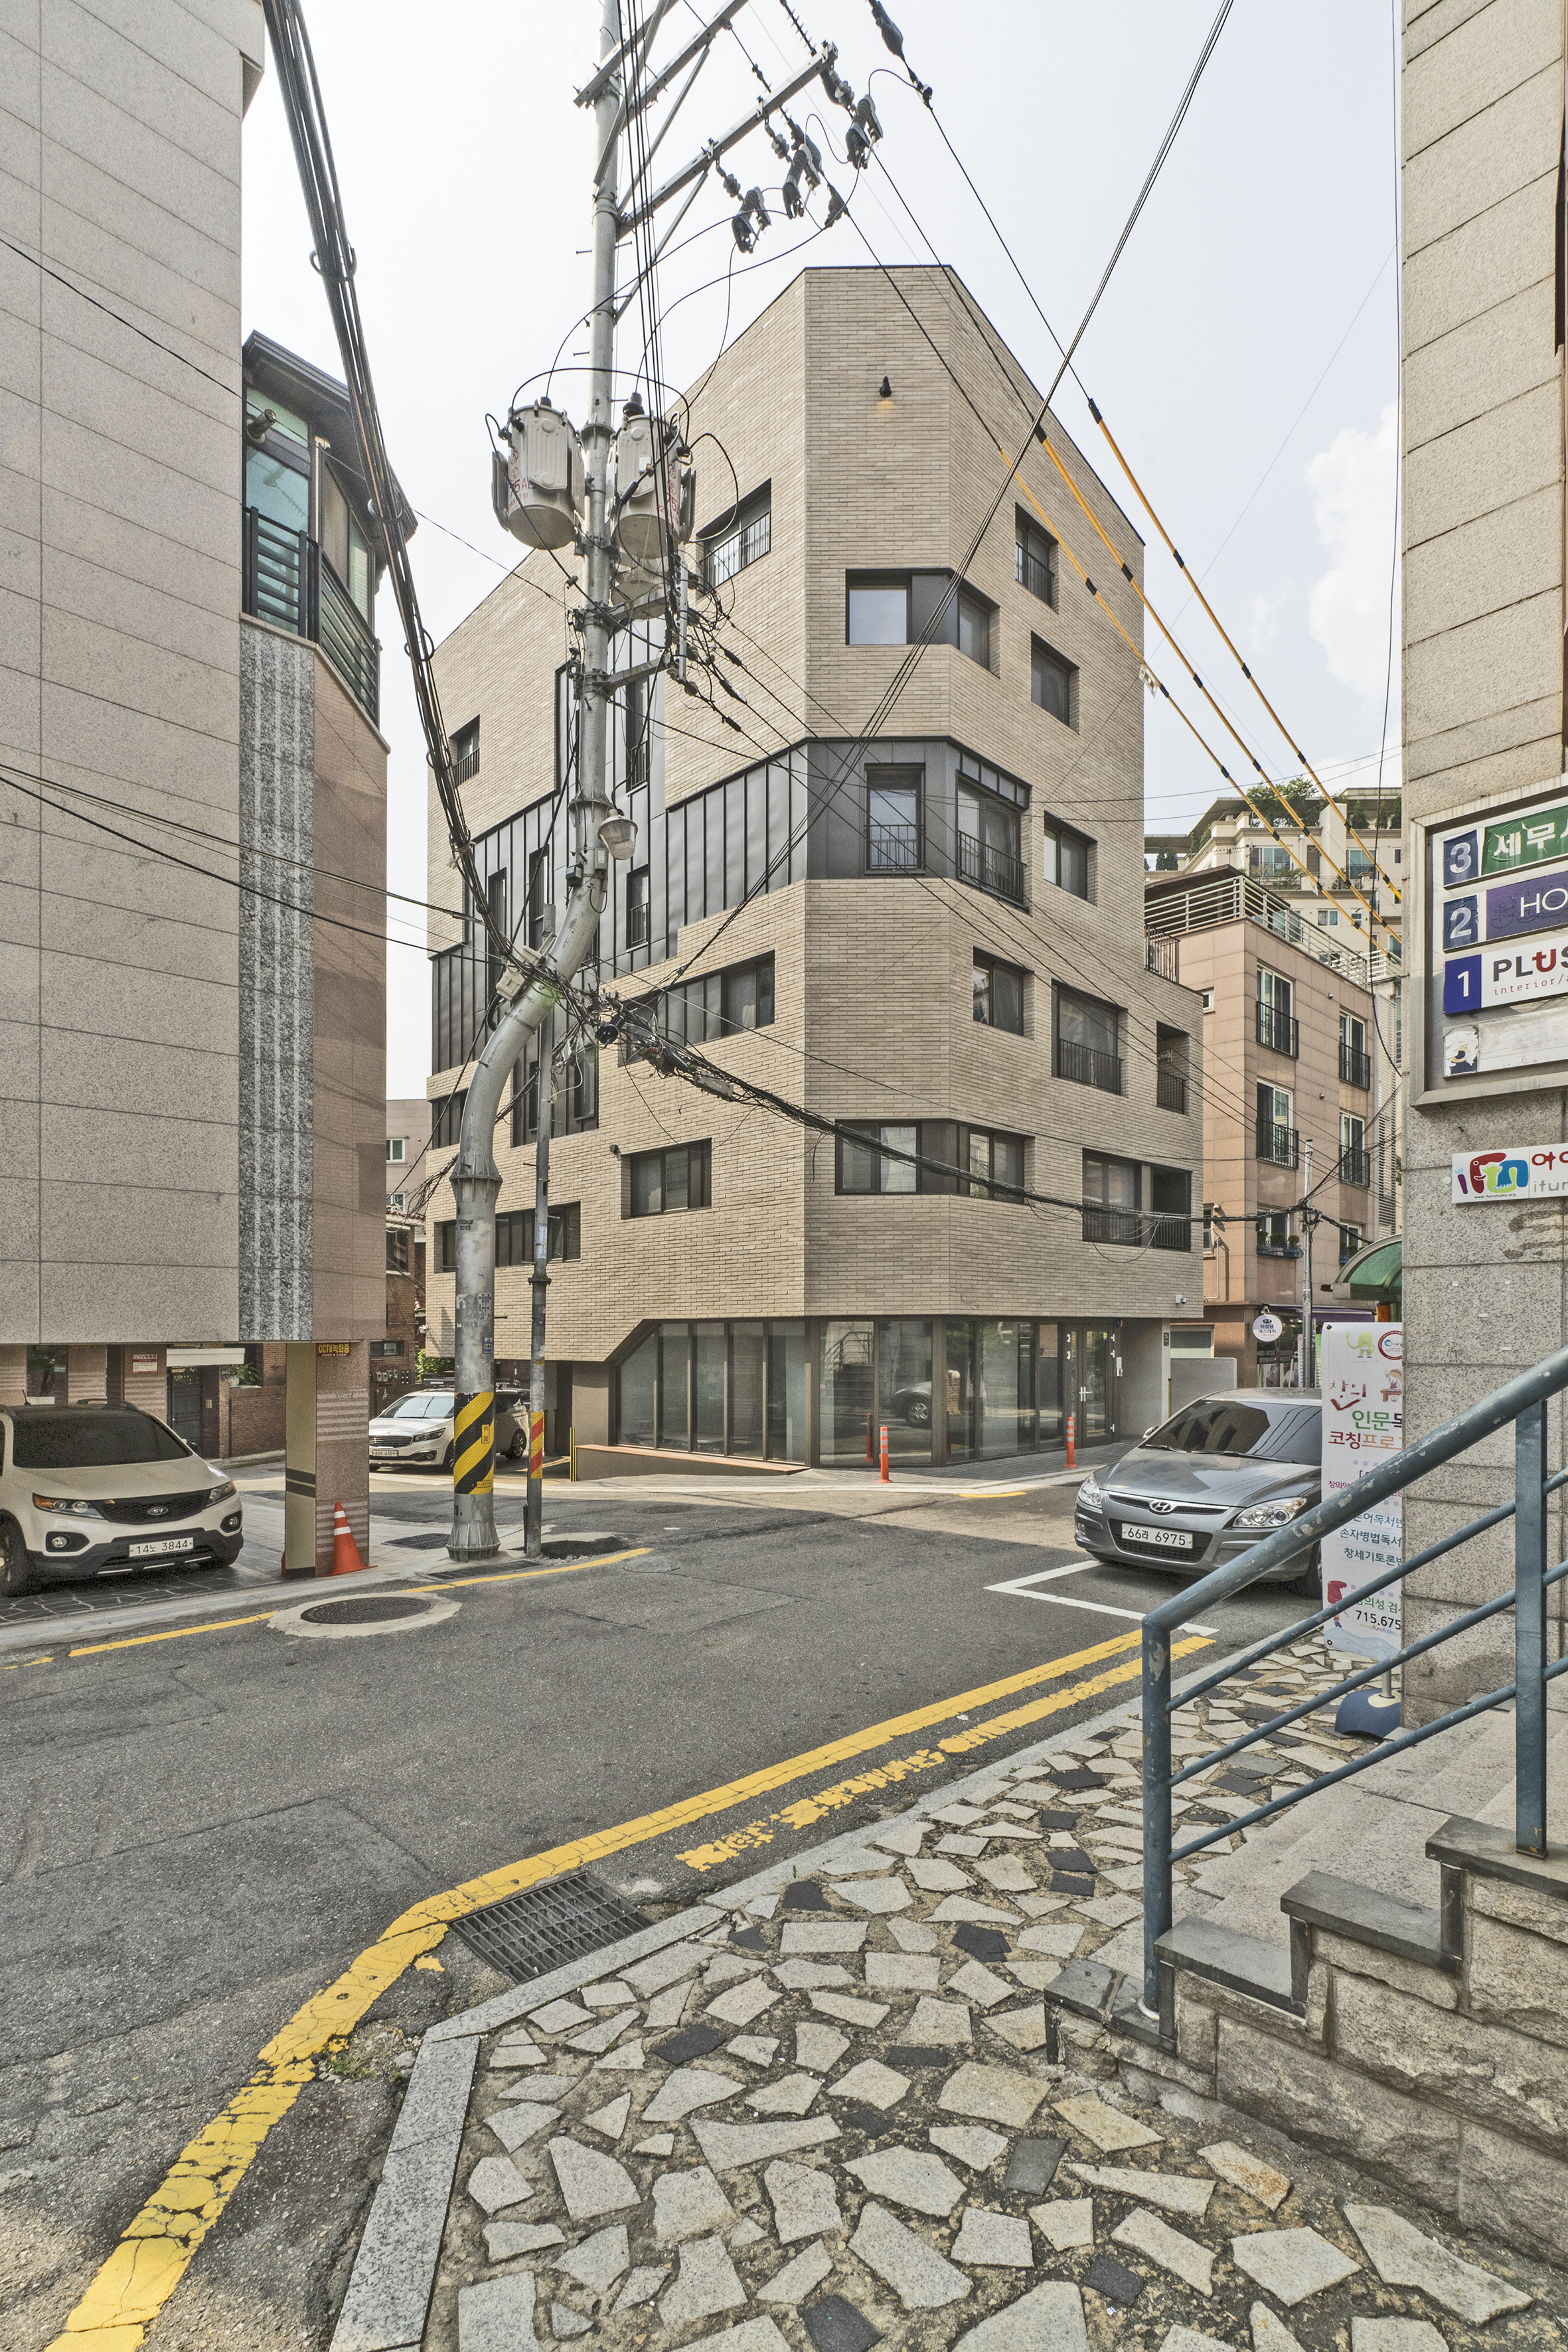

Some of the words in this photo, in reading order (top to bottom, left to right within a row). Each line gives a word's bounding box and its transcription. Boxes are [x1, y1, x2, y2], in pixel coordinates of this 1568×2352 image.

[1450, 842, 1472, 874] 3
[1450, 907, 1472, 939] 2
[1520, 888, 1568, 917] HO
[1457, 971, 1469, 997] 1
[1494, 974, 1568, 996] interior/
[319, 1344, 350, 1354] CCTV녹화중
[1128, 1528, 1149, 1539] 66라
[1155, 1531, 1186, 1545] 6975
[136, 1545, 156, 1554] 14노
[161, 1539, 189, 1551] 3844
[1388, 1601, 1401, 1614] 검
